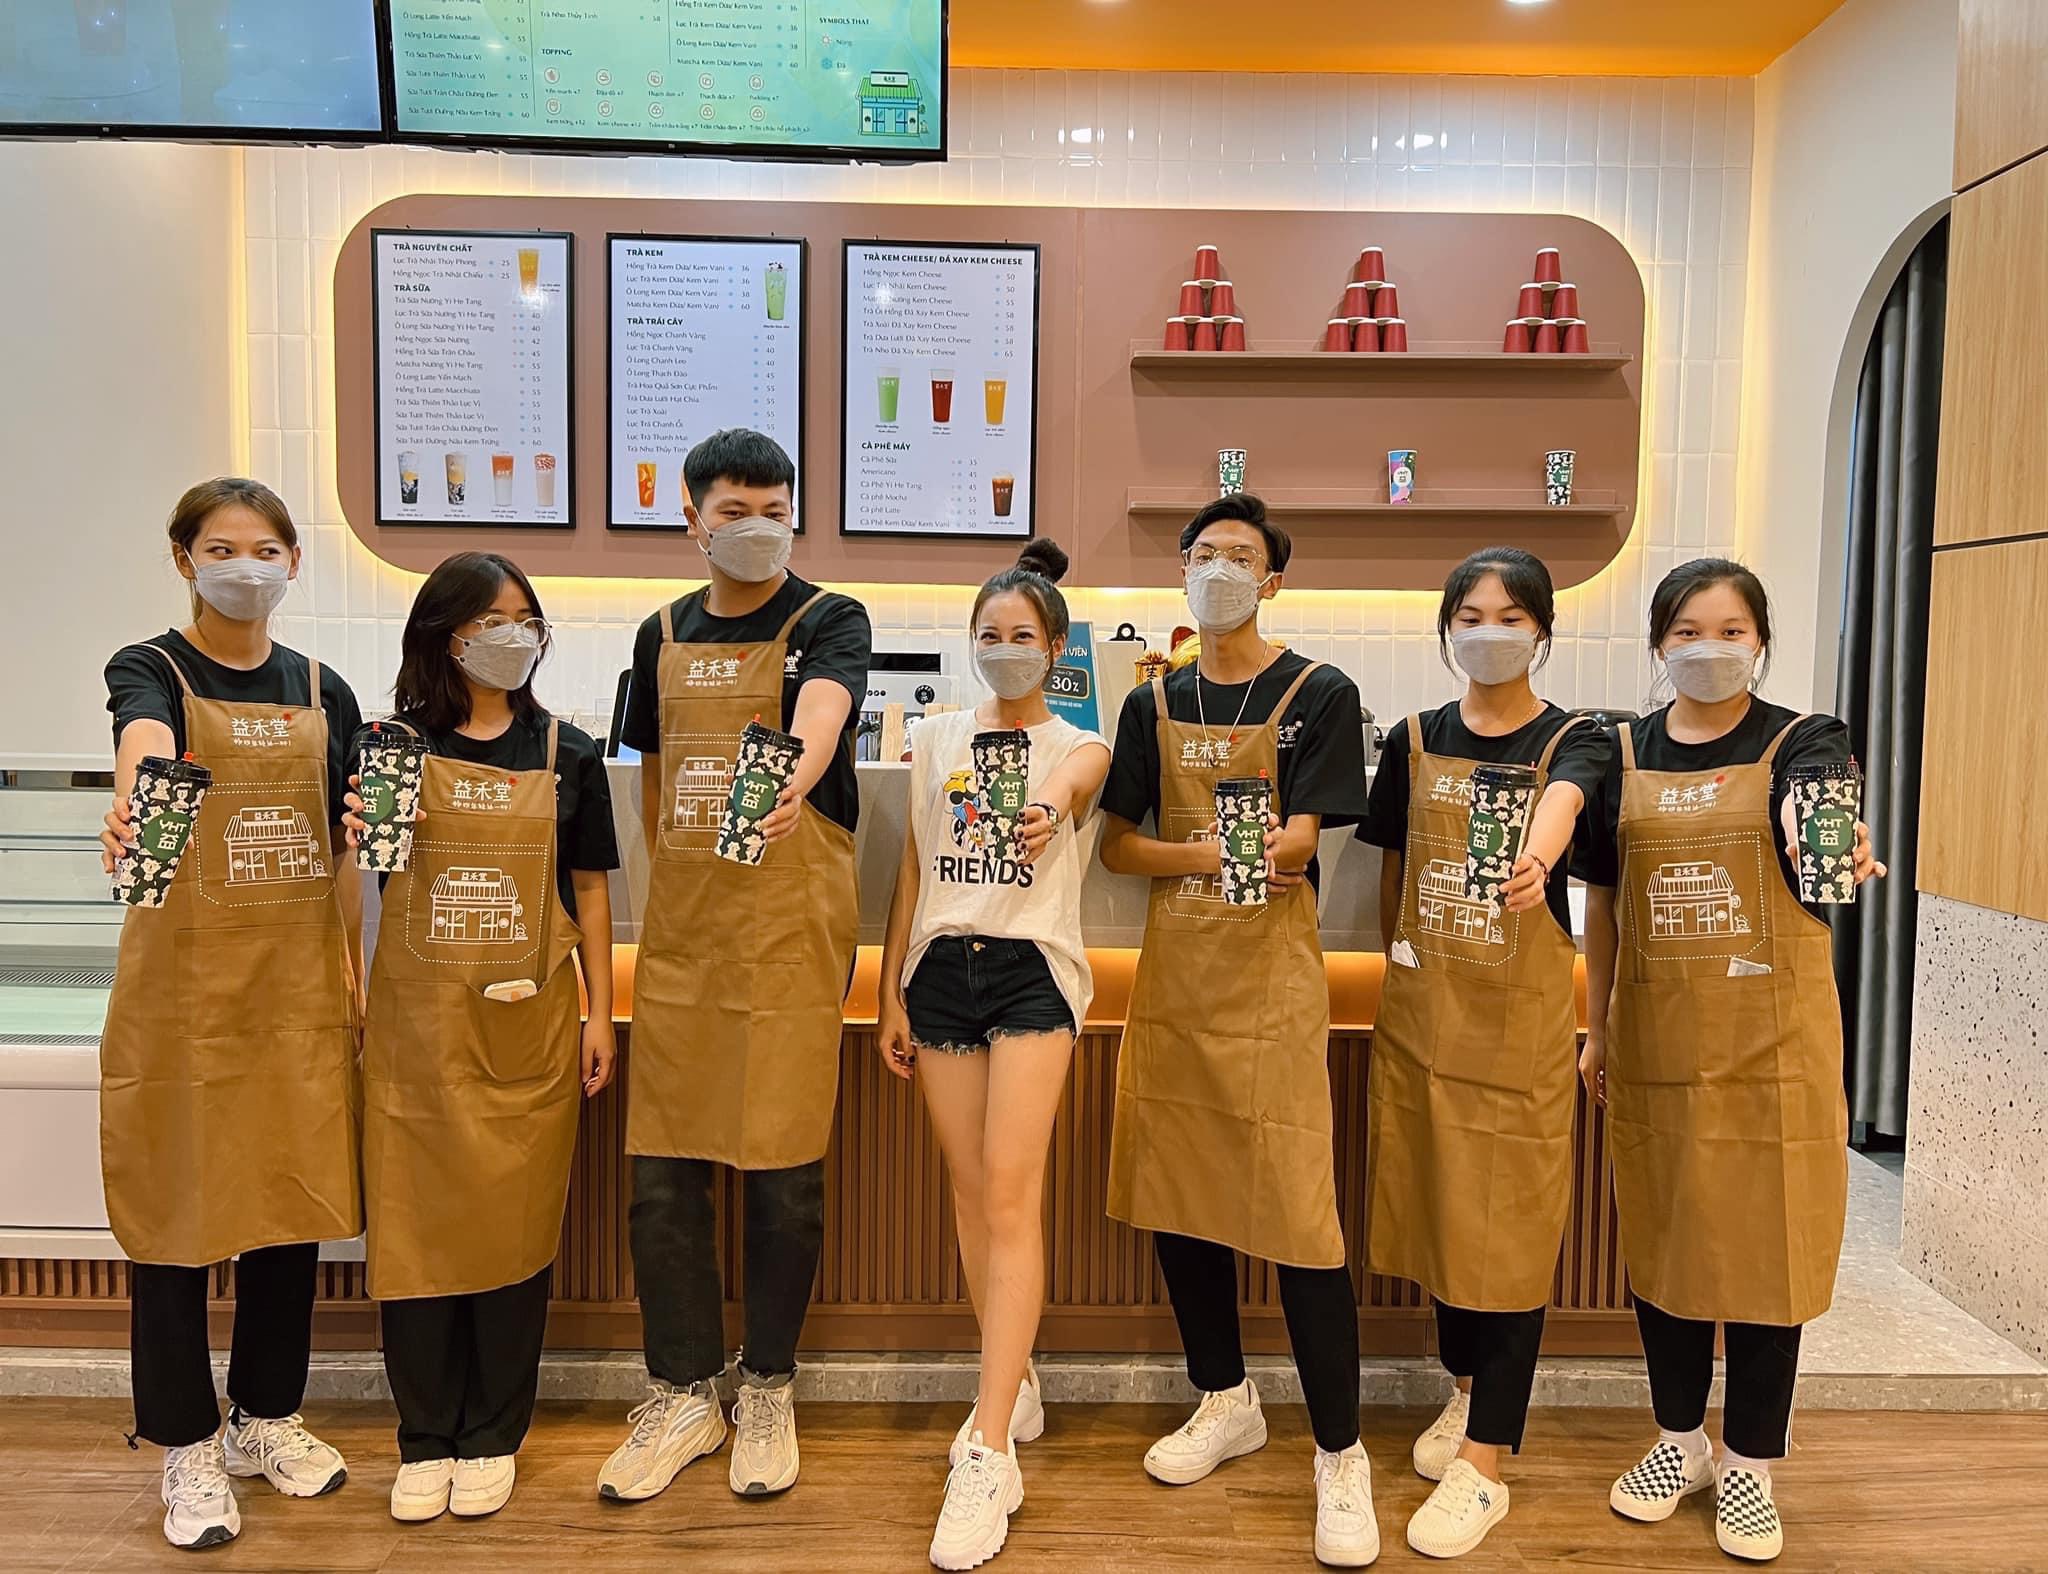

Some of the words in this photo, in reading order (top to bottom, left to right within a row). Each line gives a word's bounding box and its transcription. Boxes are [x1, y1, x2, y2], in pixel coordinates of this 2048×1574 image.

[393, 242, 411, 251] TRÀ
[412, 243, 448, 251] NGUYÊN
[449, 243, 472, 252] CHẤT
[626, 248, 643, 256] TRÀ
[645, 248, 663, 257] KEM
[864, 252, 880, 261] TRÀ
[881, 253, 900, 261] KEM
[901, 254, 937, 262] CHEESE/
[939, 255, 951, 263] ĐÁ
[970, 256, 989, 264] KEM
[990, 257, 1023, 265] CHEESE
[393, 283, 411, 292] TRÀ
[412, 283, 430, 292] SỮA
[627, 316, 644, 325] TRÀ
[645, 317, 665, 325] TRÁI
[667, 317, 683, 326] CÂY
[626, 354, 632, 363] Ô
[861, 441, 873, 449] CÀ
[874, 441, 891, 450] PHÊ
[893, 442, 911, 450] MÁY
[688, 658, 740, 680] 益禾堂
[1052, 676, 1079, 693] 30%
[232, 718, 290, 738] 益禾堂
[453, 778, 512, 802] 益禾堂
[999, 781, 1021, 792] YHT
[1659, 783, 1716, 804] 益禾堂
[1814, 818, 1844, 828] YHT
[1236, 829, 1260, 839] YHT
